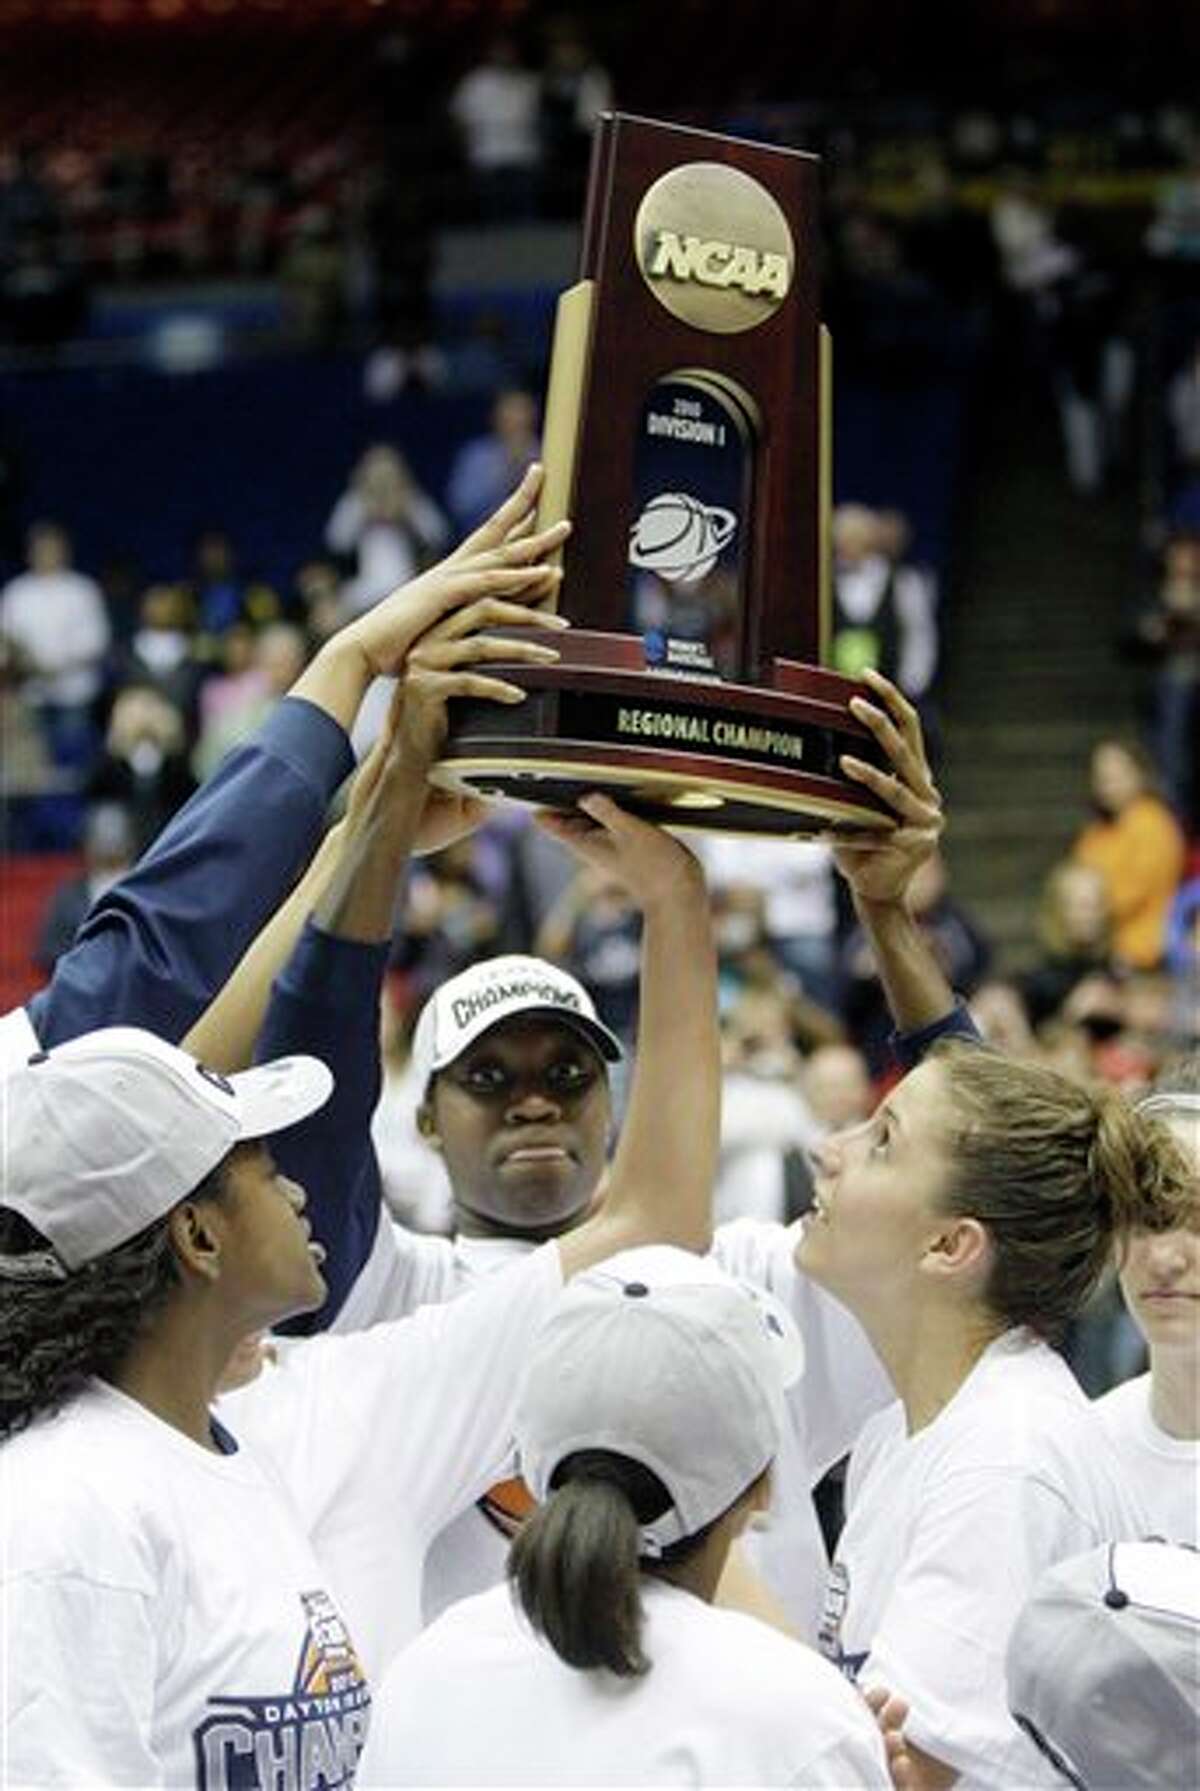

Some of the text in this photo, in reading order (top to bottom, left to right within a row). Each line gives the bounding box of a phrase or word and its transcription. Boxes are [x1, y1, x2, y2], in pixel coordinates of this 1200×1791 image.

[651, 230, 788, 299] NCAA
[647, 412, 725, 447] DIVISION I
[617, 707, 803, 759] REGIONAL CHAMPION
